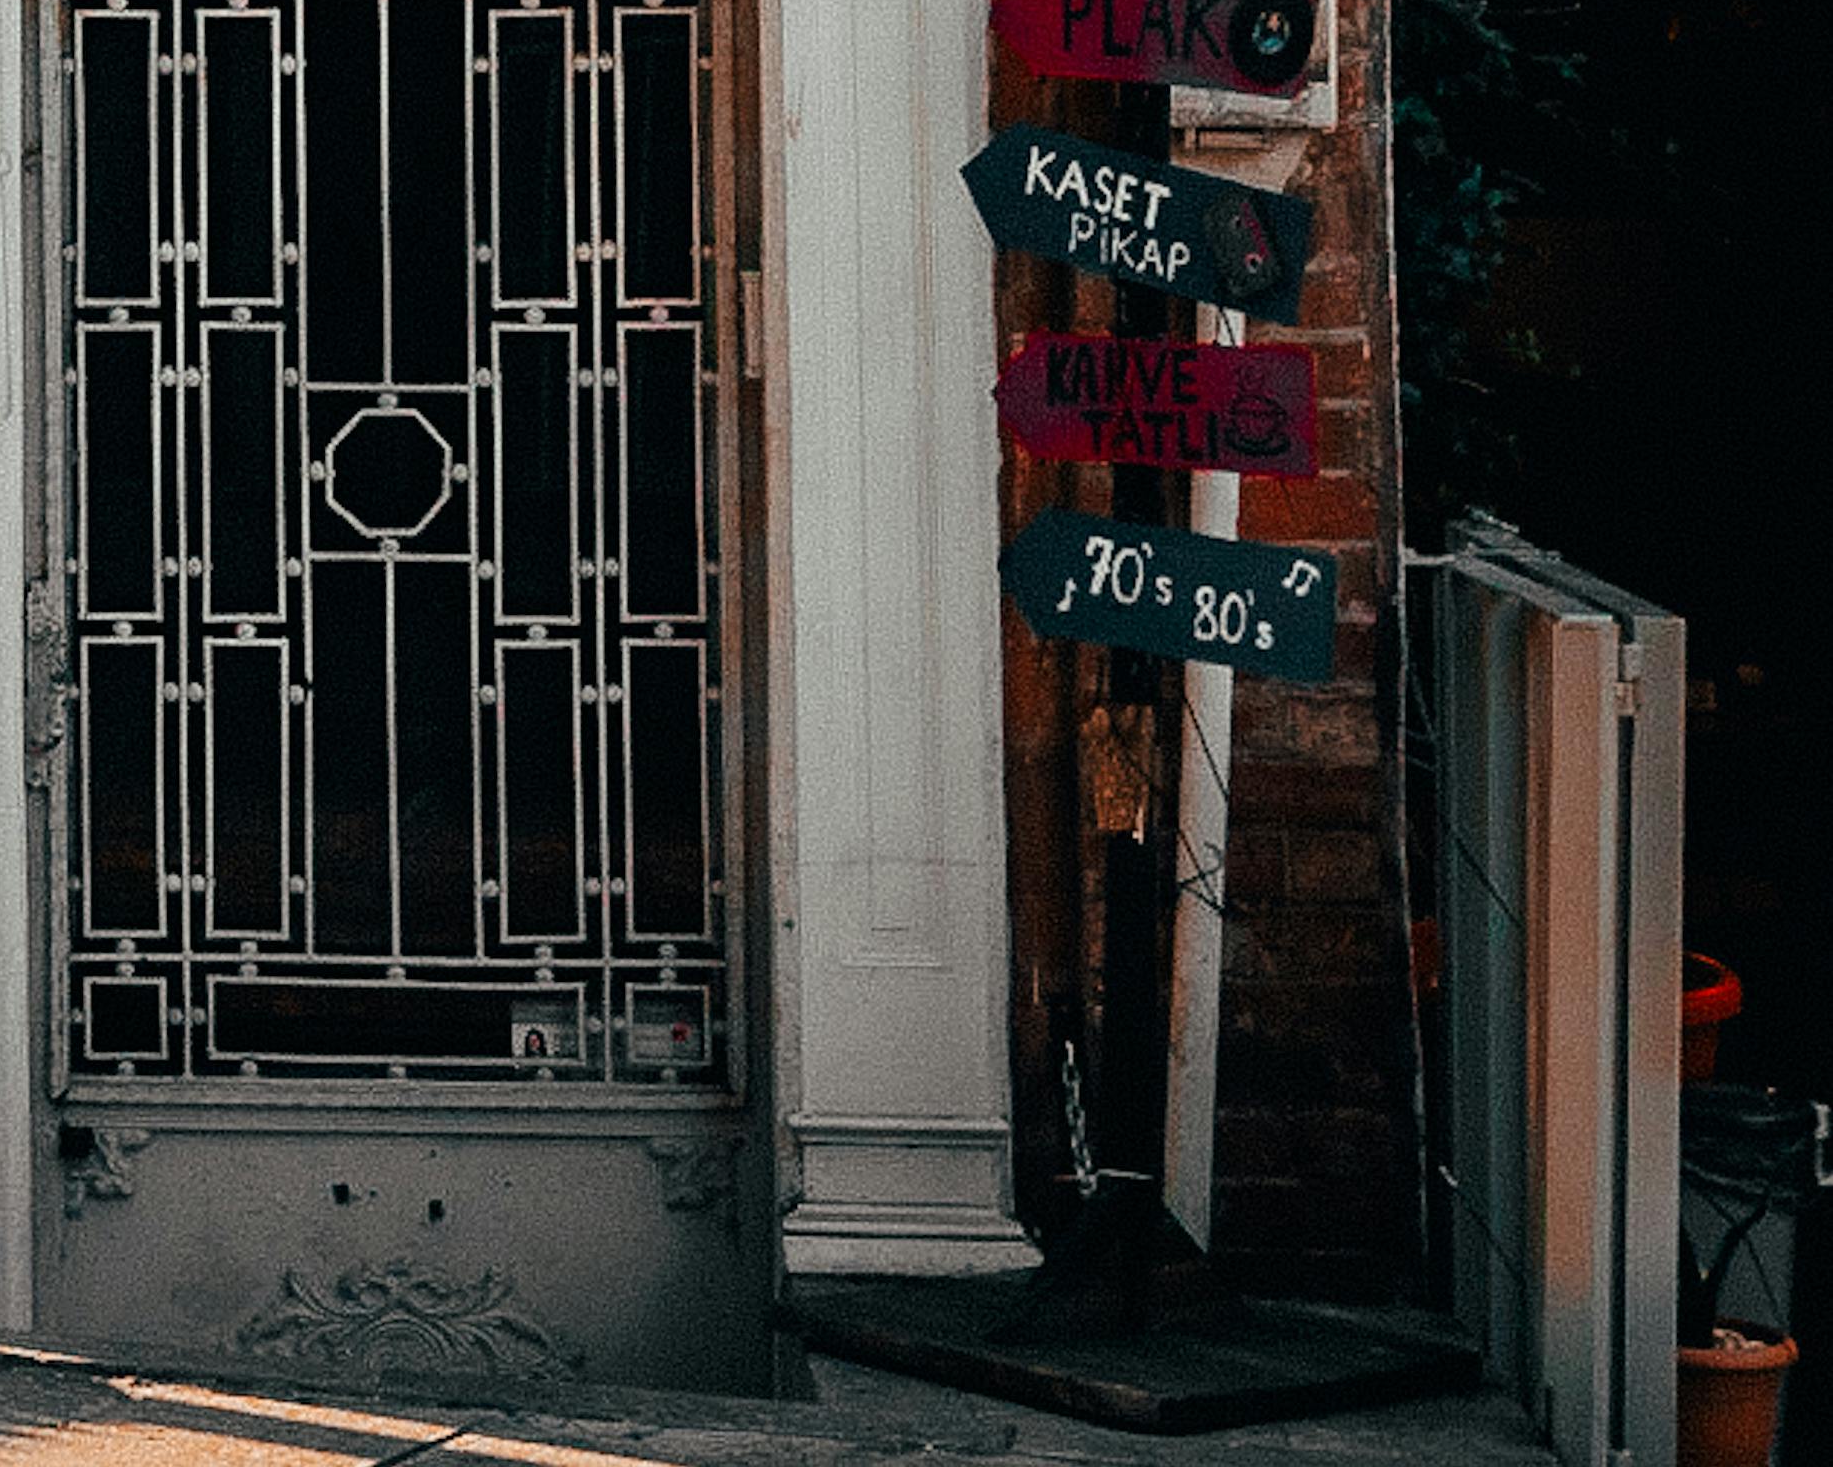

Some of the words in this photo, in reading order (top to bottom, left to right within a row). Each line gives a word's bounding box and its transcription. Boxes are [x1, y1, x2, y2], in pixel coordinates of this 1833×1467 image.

[1024, 145, 1172, 231] KASET
[1046, 342, 1199, 406] KAHVE
[1081, 408, 1218, 460] TATLI
[1085, 536, 1174, 606] 70's
[1193, 585, 1274, 650] 80's
